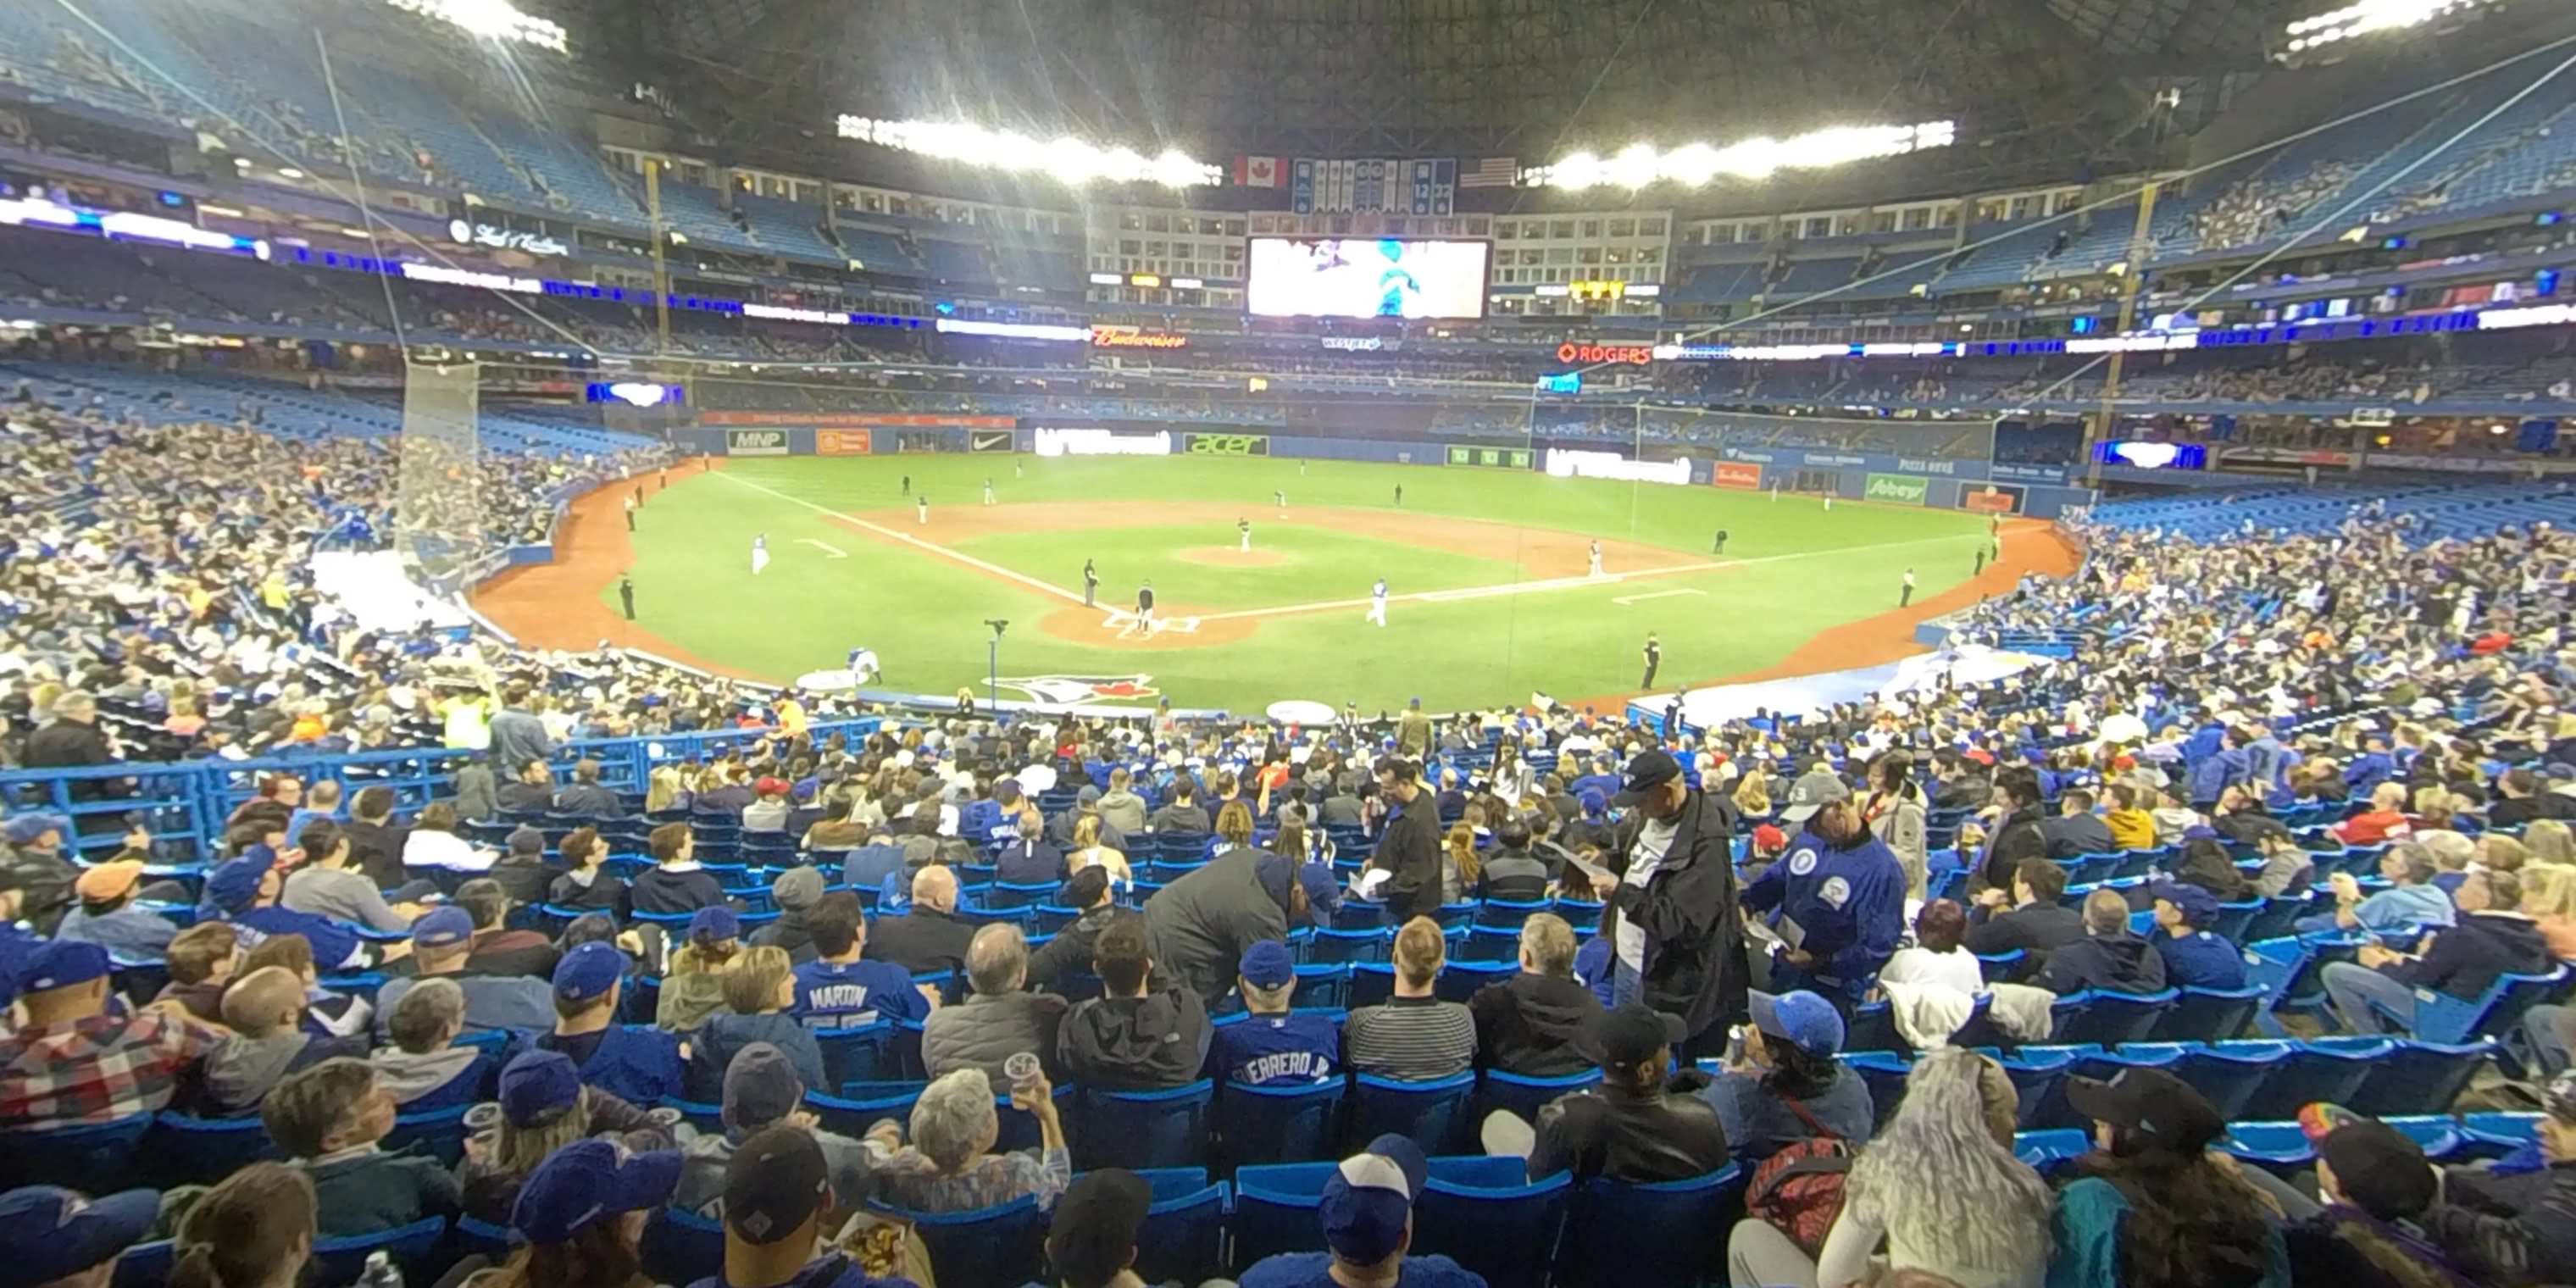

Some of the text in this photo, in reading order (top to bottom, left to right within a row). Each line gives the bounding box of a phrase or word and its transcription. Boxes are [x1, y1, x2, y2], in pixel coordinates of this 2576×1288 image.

[1415, 183, 1430, 198] 12
[1092, 329, 1186, 347] Budweiser
[1579, 346, 1652, 365] ROGERS
[735, 431, 780, 448] MNP
[1191, 433, 1262, 455] acer
[809, 984, 867, 1010] MARTIN
